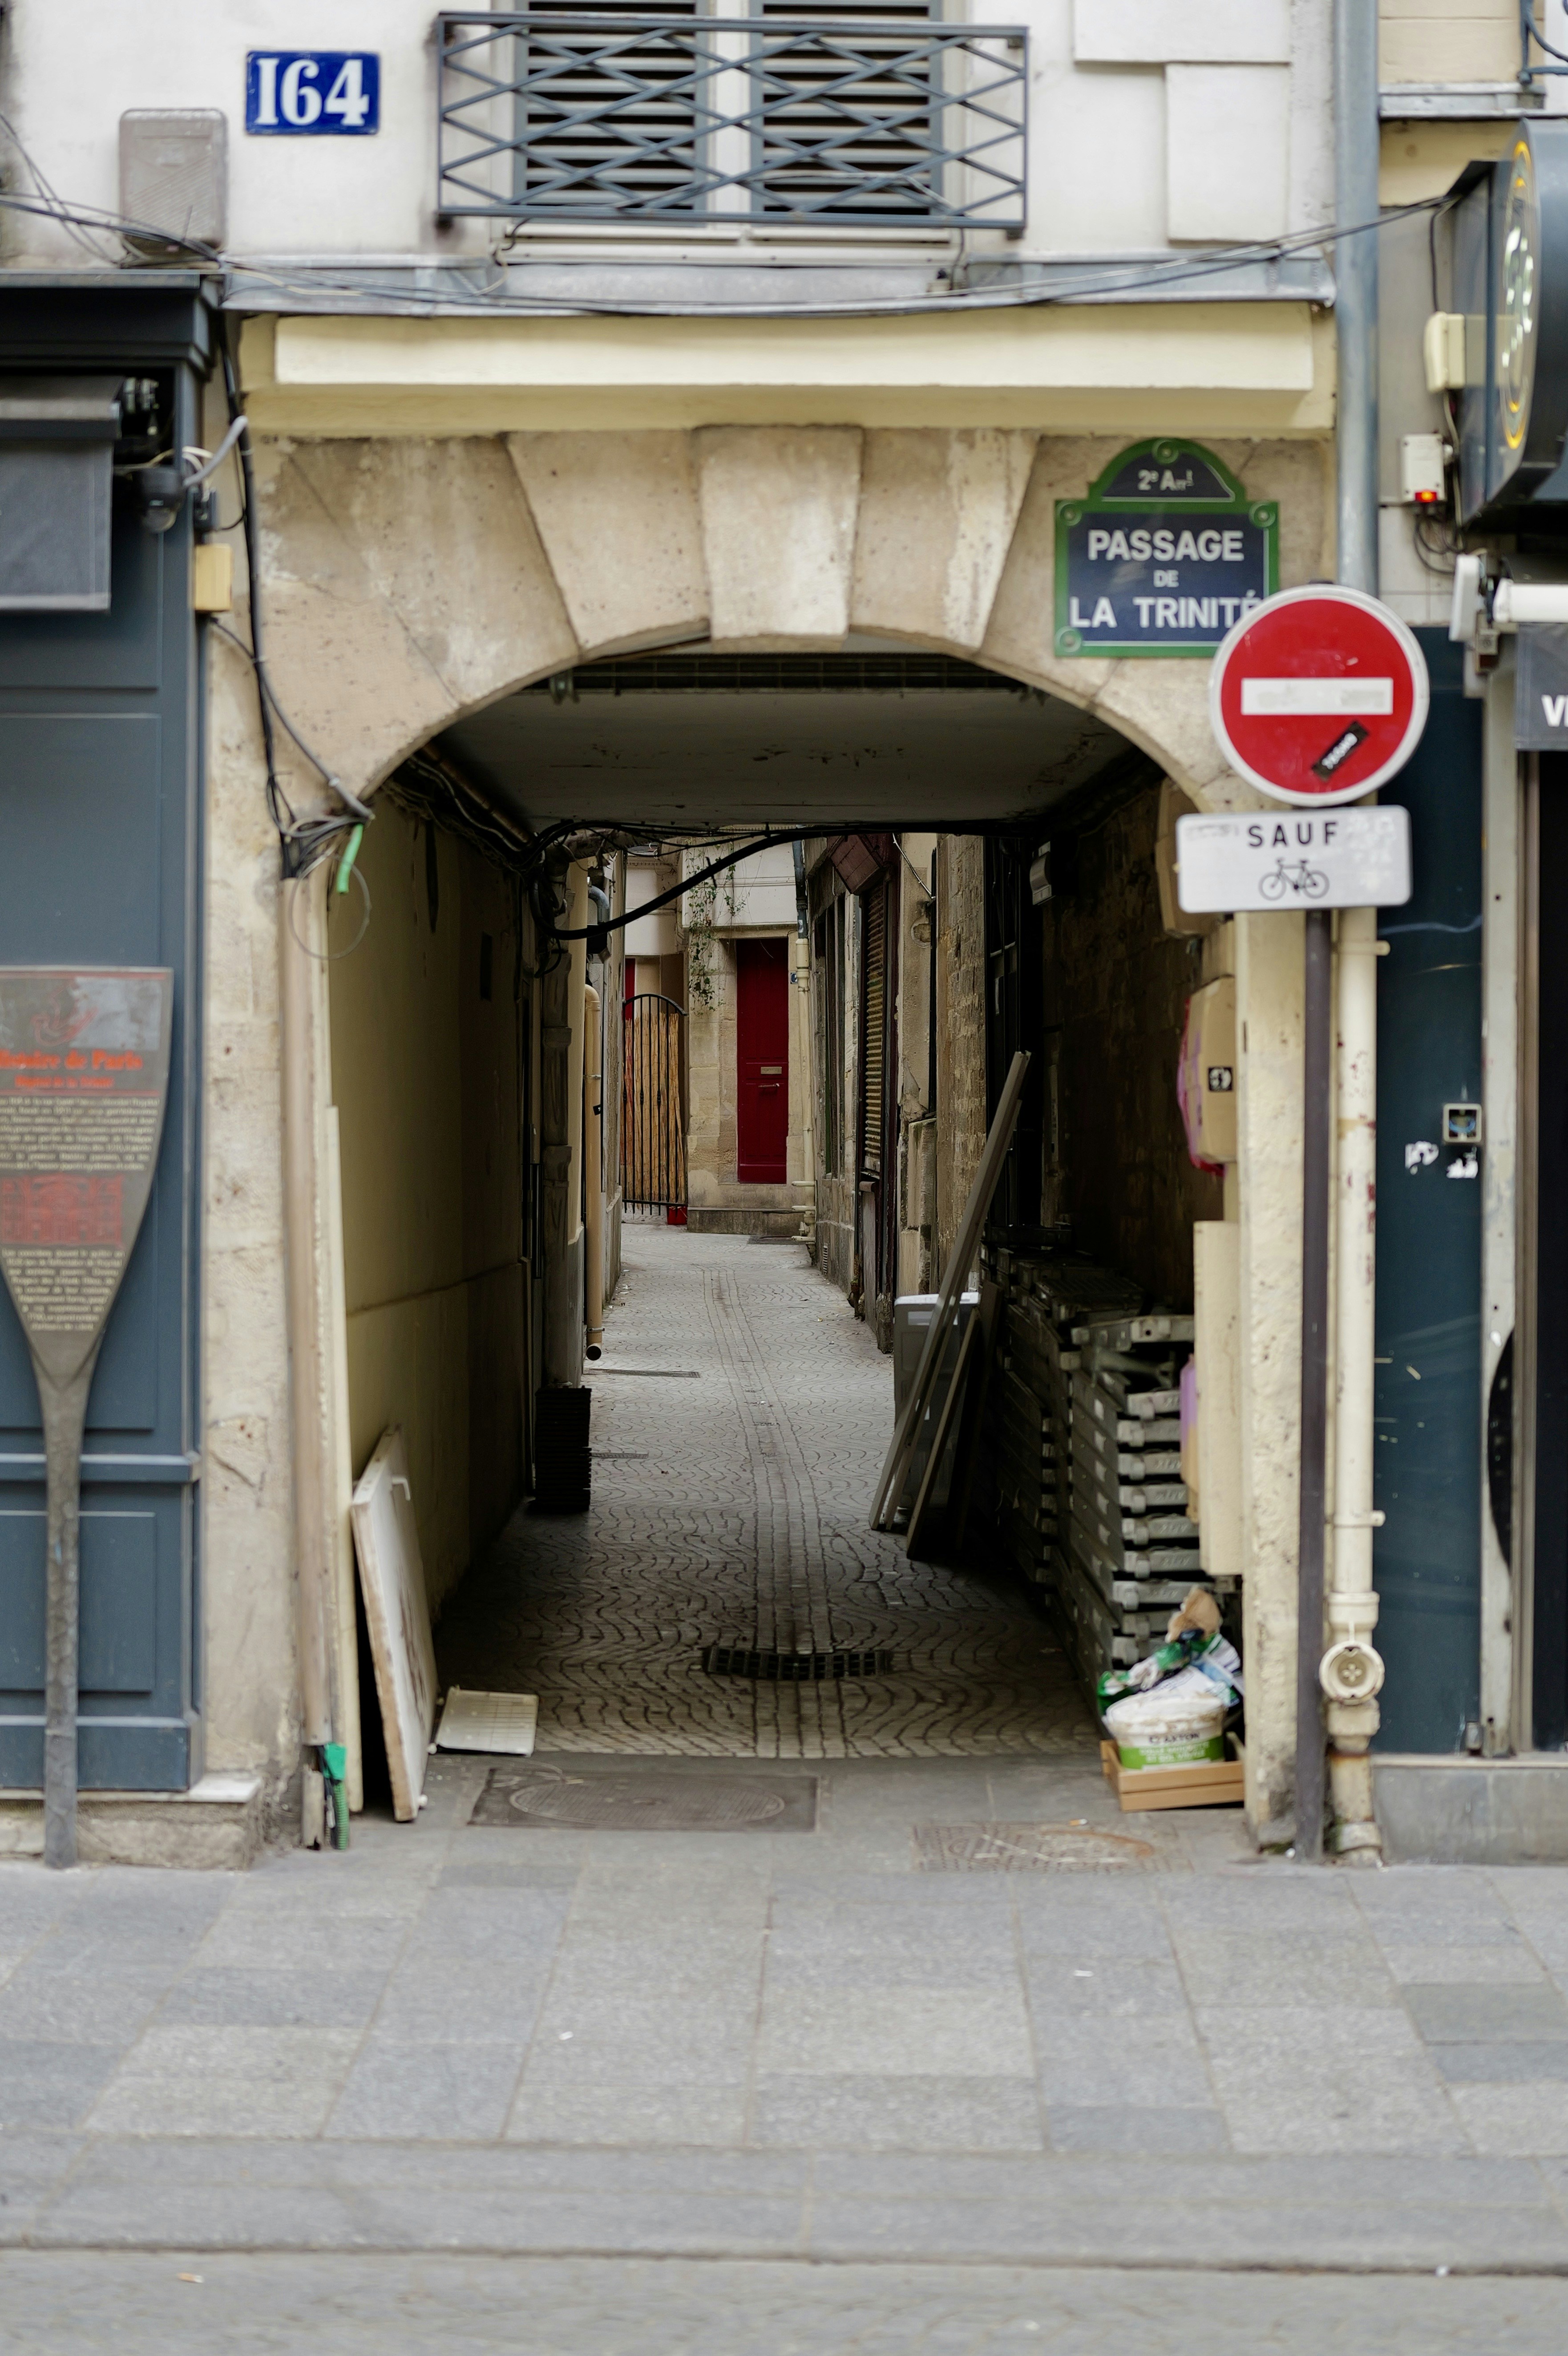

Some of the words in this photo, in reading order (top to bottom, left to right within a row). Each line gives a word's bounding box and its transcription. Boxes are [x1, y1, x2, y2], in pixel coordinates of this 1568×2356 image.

[254, 58, 370, 126] 164
[1088, 529, 1244, 562] PASSAGE
[1153, 570, 1179, 587] DE
[1070, 597, 1117, 628] LA
[1247, 822, 1337, 847] SAUF
